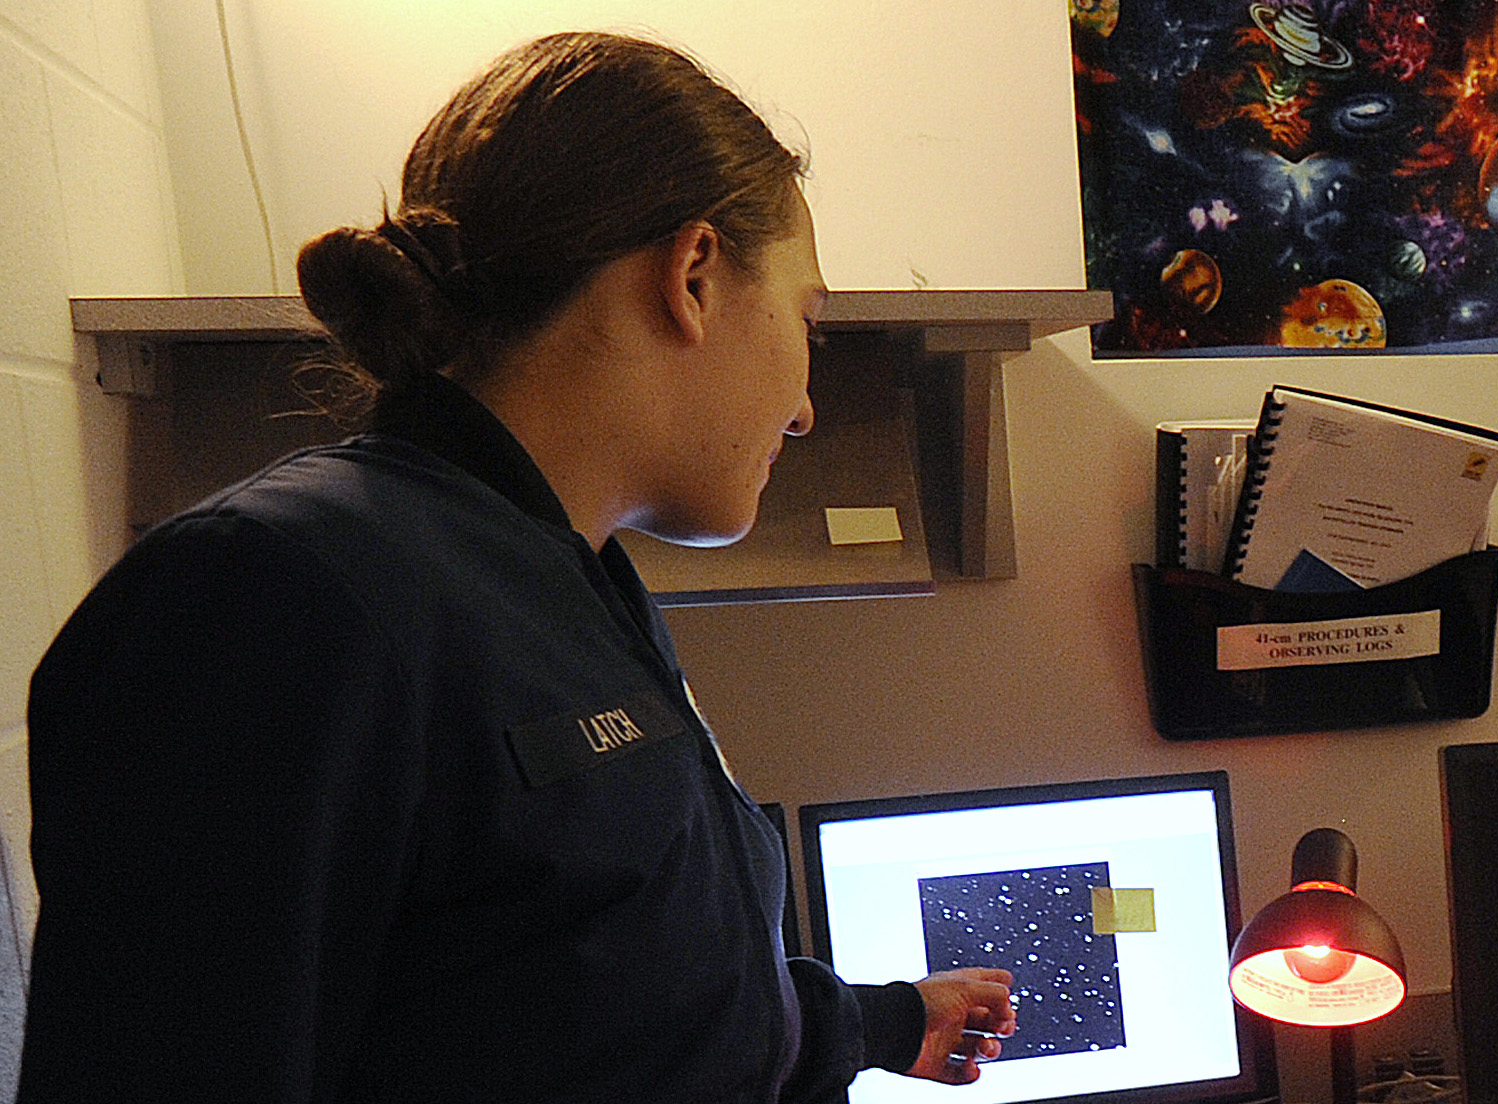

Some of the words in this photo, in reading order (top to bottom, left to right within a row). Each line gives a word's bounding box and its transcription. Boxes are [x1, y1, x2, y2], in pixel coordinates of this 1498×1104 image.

[1298, 624, 1389, 643] PROCEDURES
[1269, 643, 1350, 659] OBSERVING
[1356, 640, 1394, 653] LOGS
